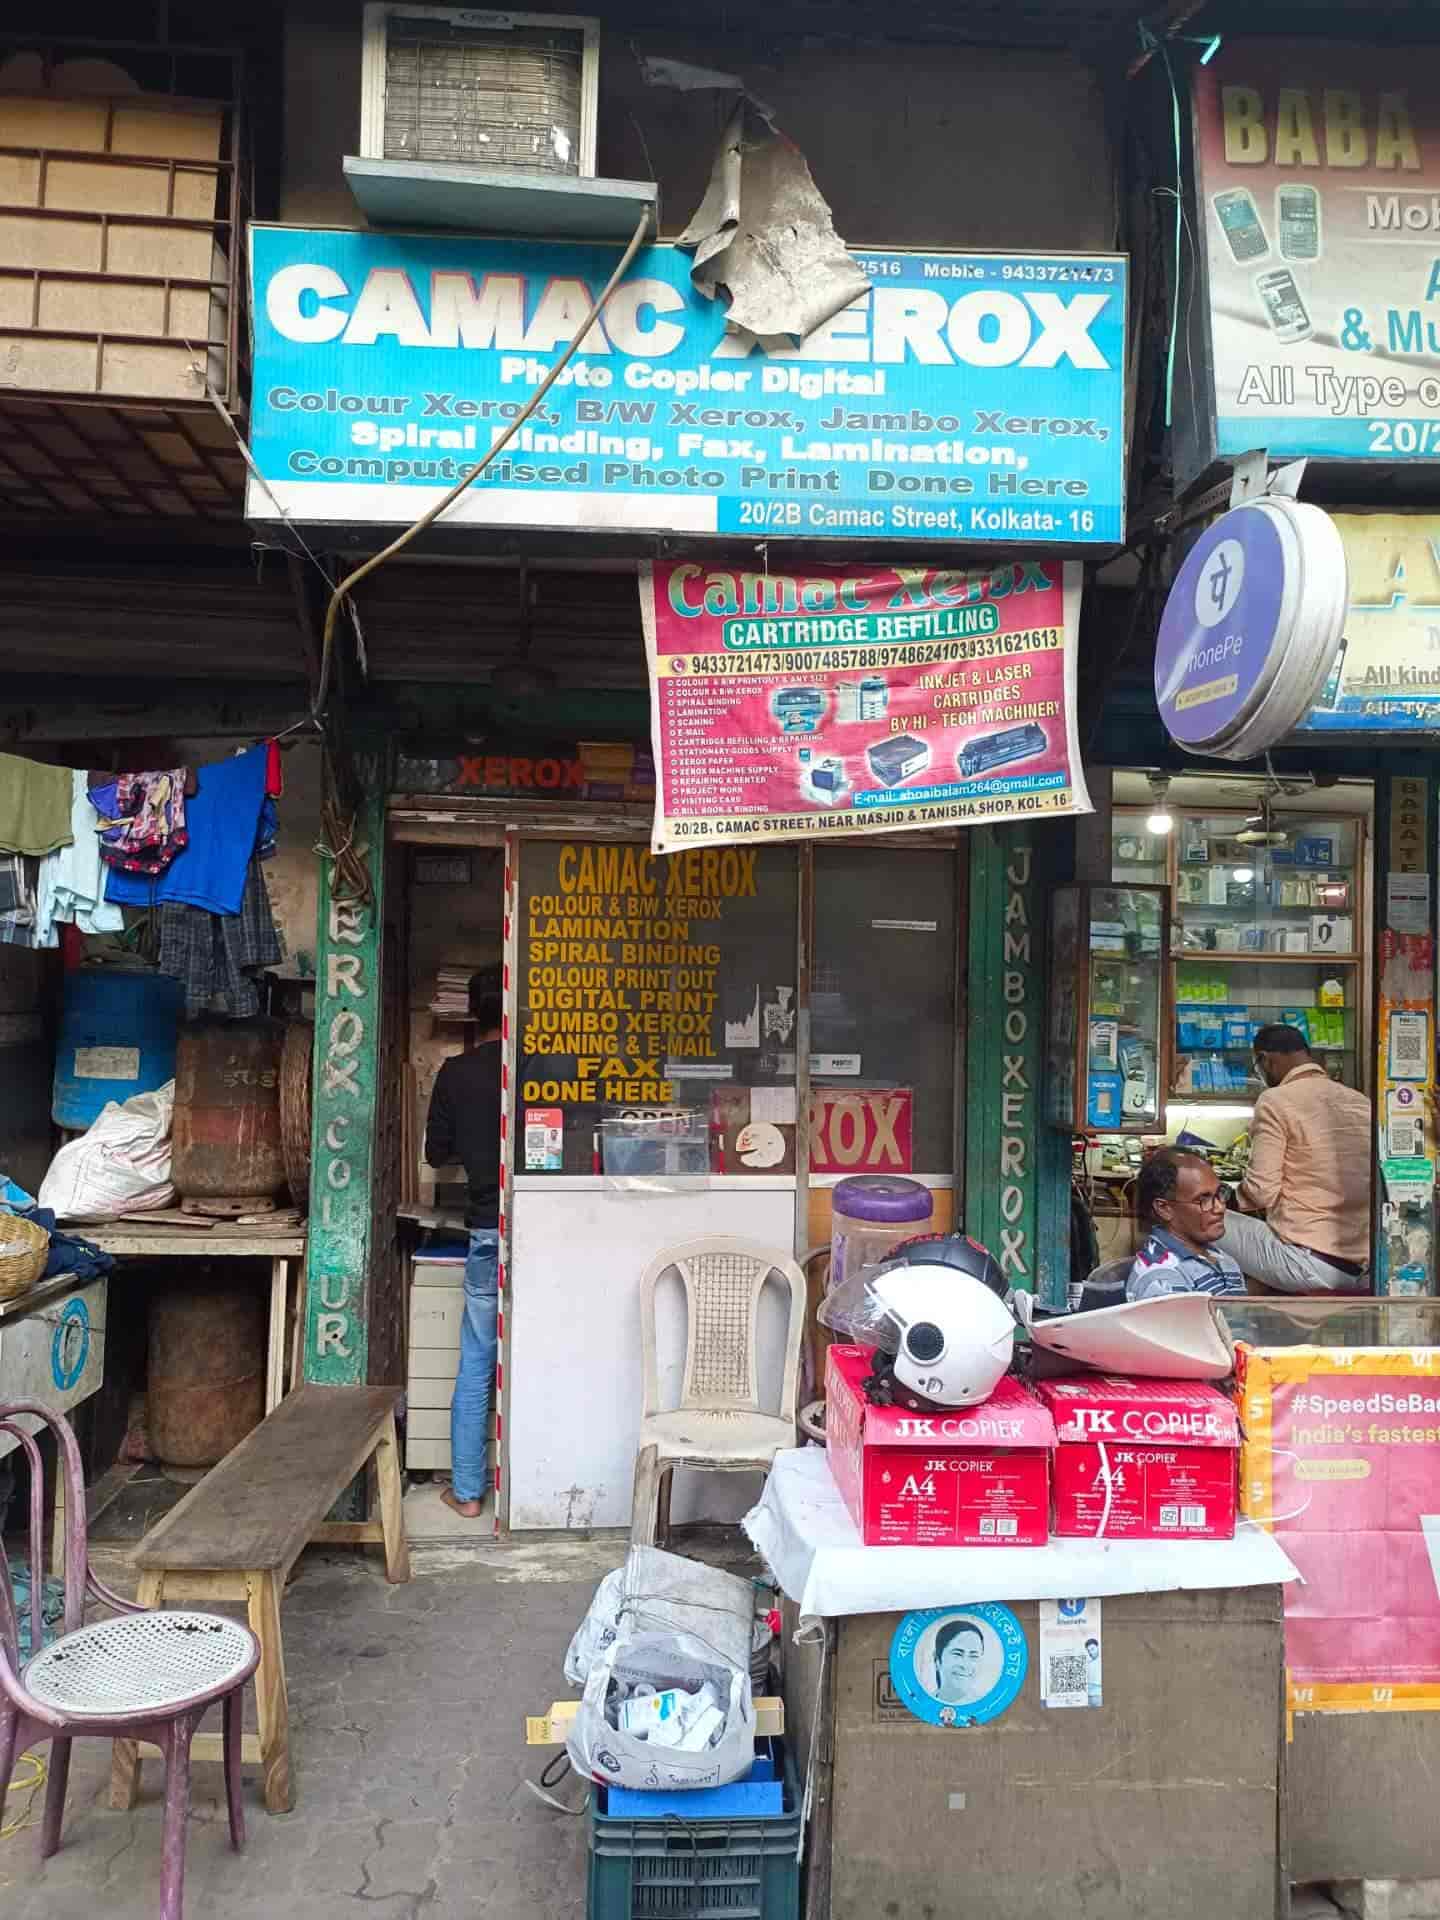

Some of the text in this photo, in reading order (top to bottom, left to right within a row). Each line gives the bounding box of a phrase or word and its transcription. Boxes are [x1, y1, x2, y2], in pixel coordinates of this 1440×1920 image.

[1221, 86, 1421, 170] BABA
[924, 263, 985, 279] Mobile
[1002, 264, 1115, 283] 9433721473
[266, 263, 685, 357] CAMAC
[1341, 308, 1373, 351] &
[501, 357, 885, 399] Photo Copier Digital
[1238, 365, 1407, 416] All Type
[269, 387, 1111, 442] Colour Xerox, B/W Xerox, Jambo Xerox,
[350, 421, 1029, 470] Spiral Binding, Fax, Lamination,
[288, 450, 1090, 497] Computerised Photo Print Done Here
[738, 501, 1095, 533] 20/2B Camac Street, Kolkata- 16
[667, 562, 1054, 618] Camac Xerox
[729, 607, 994, 647] CARTRIDGE REFILLING
[919, 663, 1032, 690] INKJET & LASER
[1364, 665, 1391, 684] All
[932, 684, 1021, 709] CARTRIDGES
[676, 708, 728, 717] LAMINATION
[676, 718, 715, 727] SCANING
[890, 717, 908, 732] BY
[912, 715, 928, 730] HI
[942, 711, 977, 728] TECH
[457, 755, 585, 788] XEROX
[674, 822, 713, 836] 20/2B,
[716, 820, 760, 834] CAMAC
[763, 817, 816, 831] STREET,
[818, 814, 852, 828] NEAR
[856, 809, 904, 826] MASJID
[908, 808, 917, 821] &
[921, 802, 975, 820] TANISHA
[1017, 796, 1042, 811] KOL
[1053, 793, 1067, 806] 16
[558, 846, 758, 897] CAMAC XEROX
[528, 895, 722, 919] COLOUR & B/W XEROX
[528, 917, 689, 940] LAMINATION
[528, 940, 721, 965] SPIRAL BINDING
[528, 967, 717, 990] COLOUR PRINT OUT
[528, 988, 719, 1013] DIGITAL PRINT
[524, 1011, 713, 1034] JUMBO XEROX
[523, 1033, 718, 1057] SCANING & E-MAIL
[576, 1057, 661, 1079] FAX
[1000, 846, 1032, 1276] JAMBO XEROX
[523, 1081, 673, 1102] DONE HERE
[895, 1418, 1025, 1439] JK COPIER
[1066, 1409, 1117, 1433] JK
[1122, 1410, 1218, 1436] COPIER
[1291, 1425, 1363, 1444] India's
[924, 1460, 994, 1472] JK COPIER
[1113, 1452, 1177, 1464] JK COPIER
[898, 1474, 937, 1496] A4
[1092, 1465, 1126, 1487] A4
